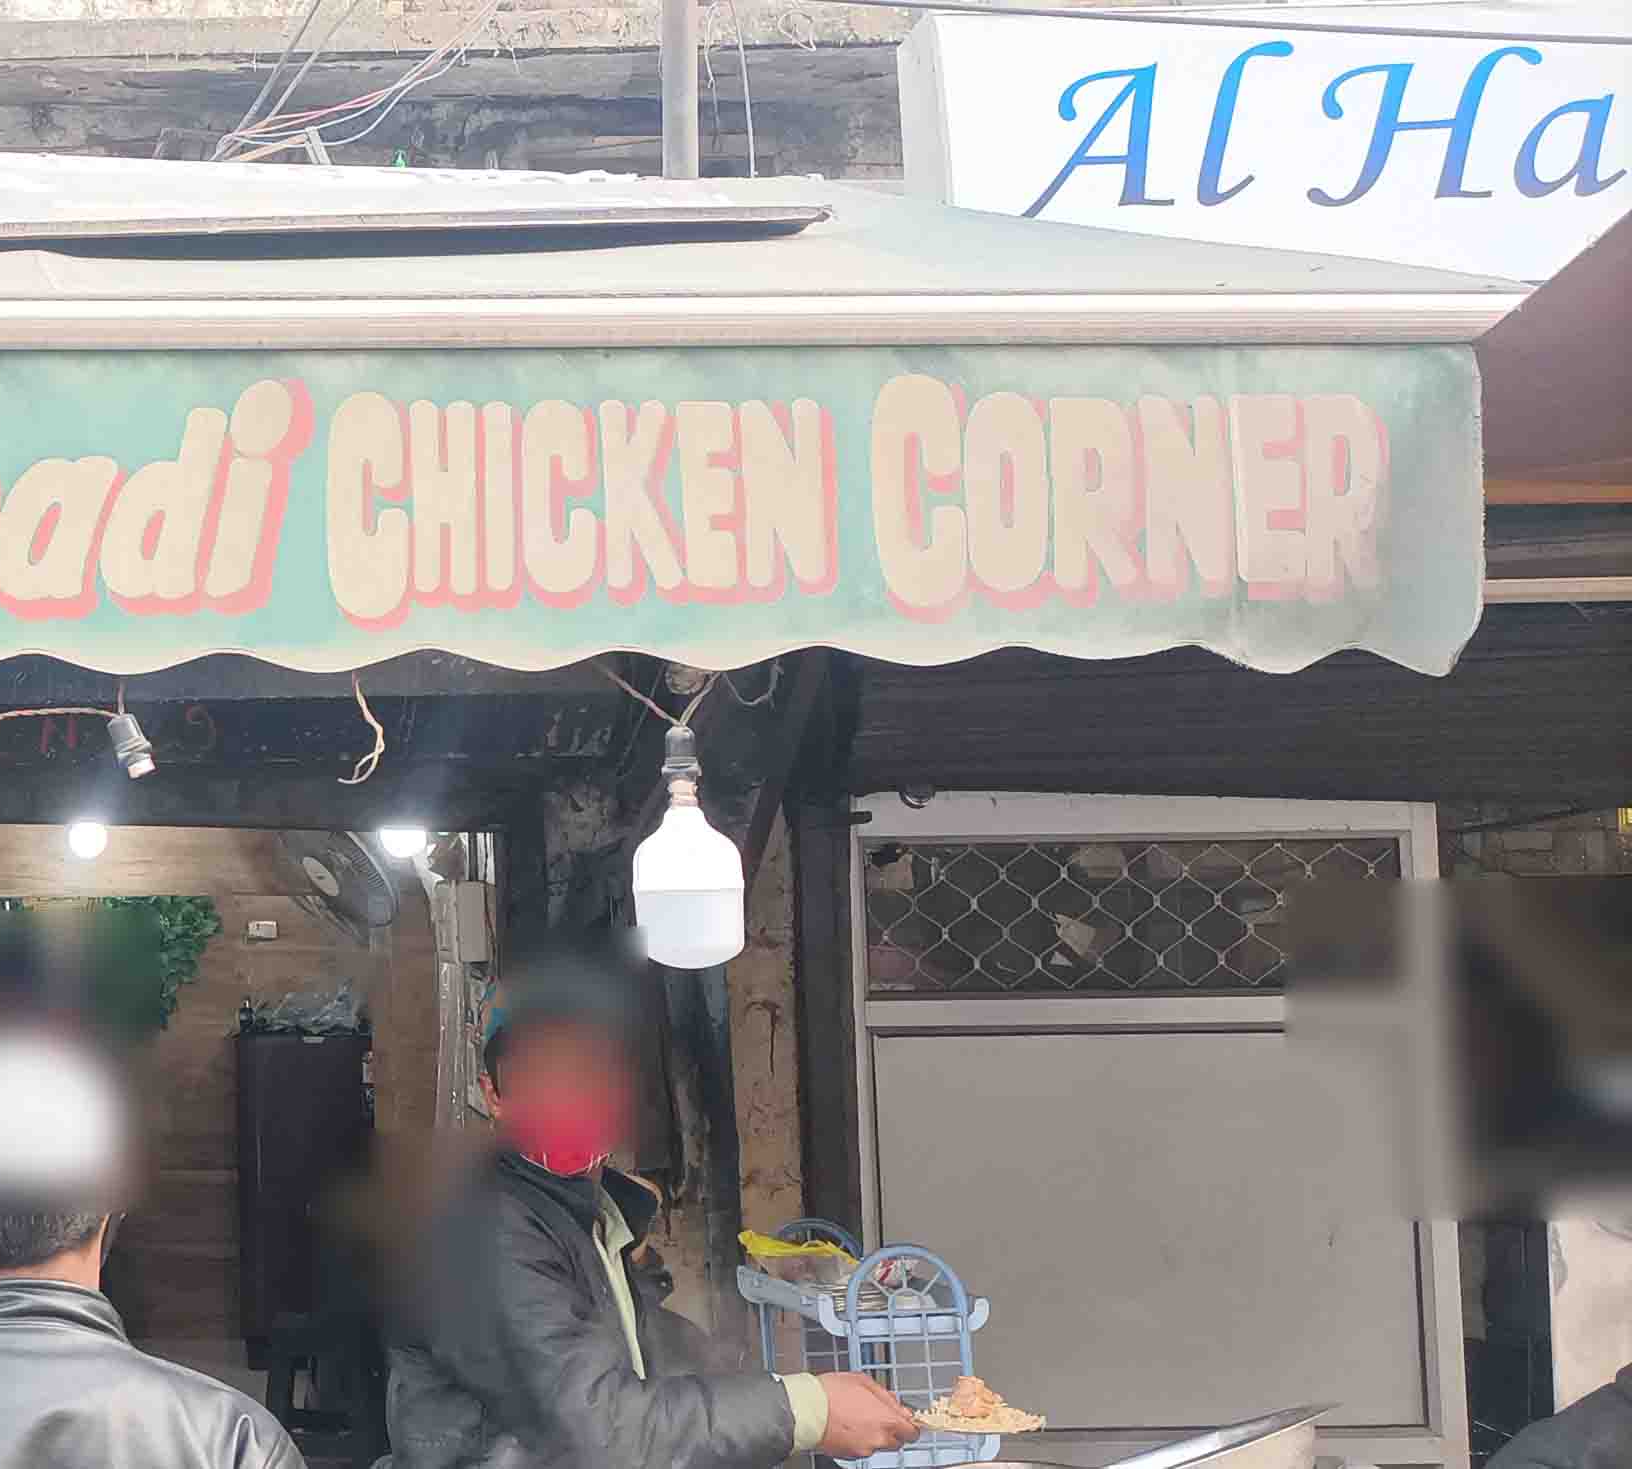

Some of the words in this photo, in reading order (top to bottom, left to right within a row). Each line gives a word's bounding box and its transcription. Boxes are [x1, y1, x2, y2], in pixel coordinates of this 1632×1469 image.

[1021, 41, 1294, 217] Al
[1307, 46, 1628, 207] Ha
[327, 391, 839, 632] CHICKEN
[871, 373, 1389, 624] CORNER
